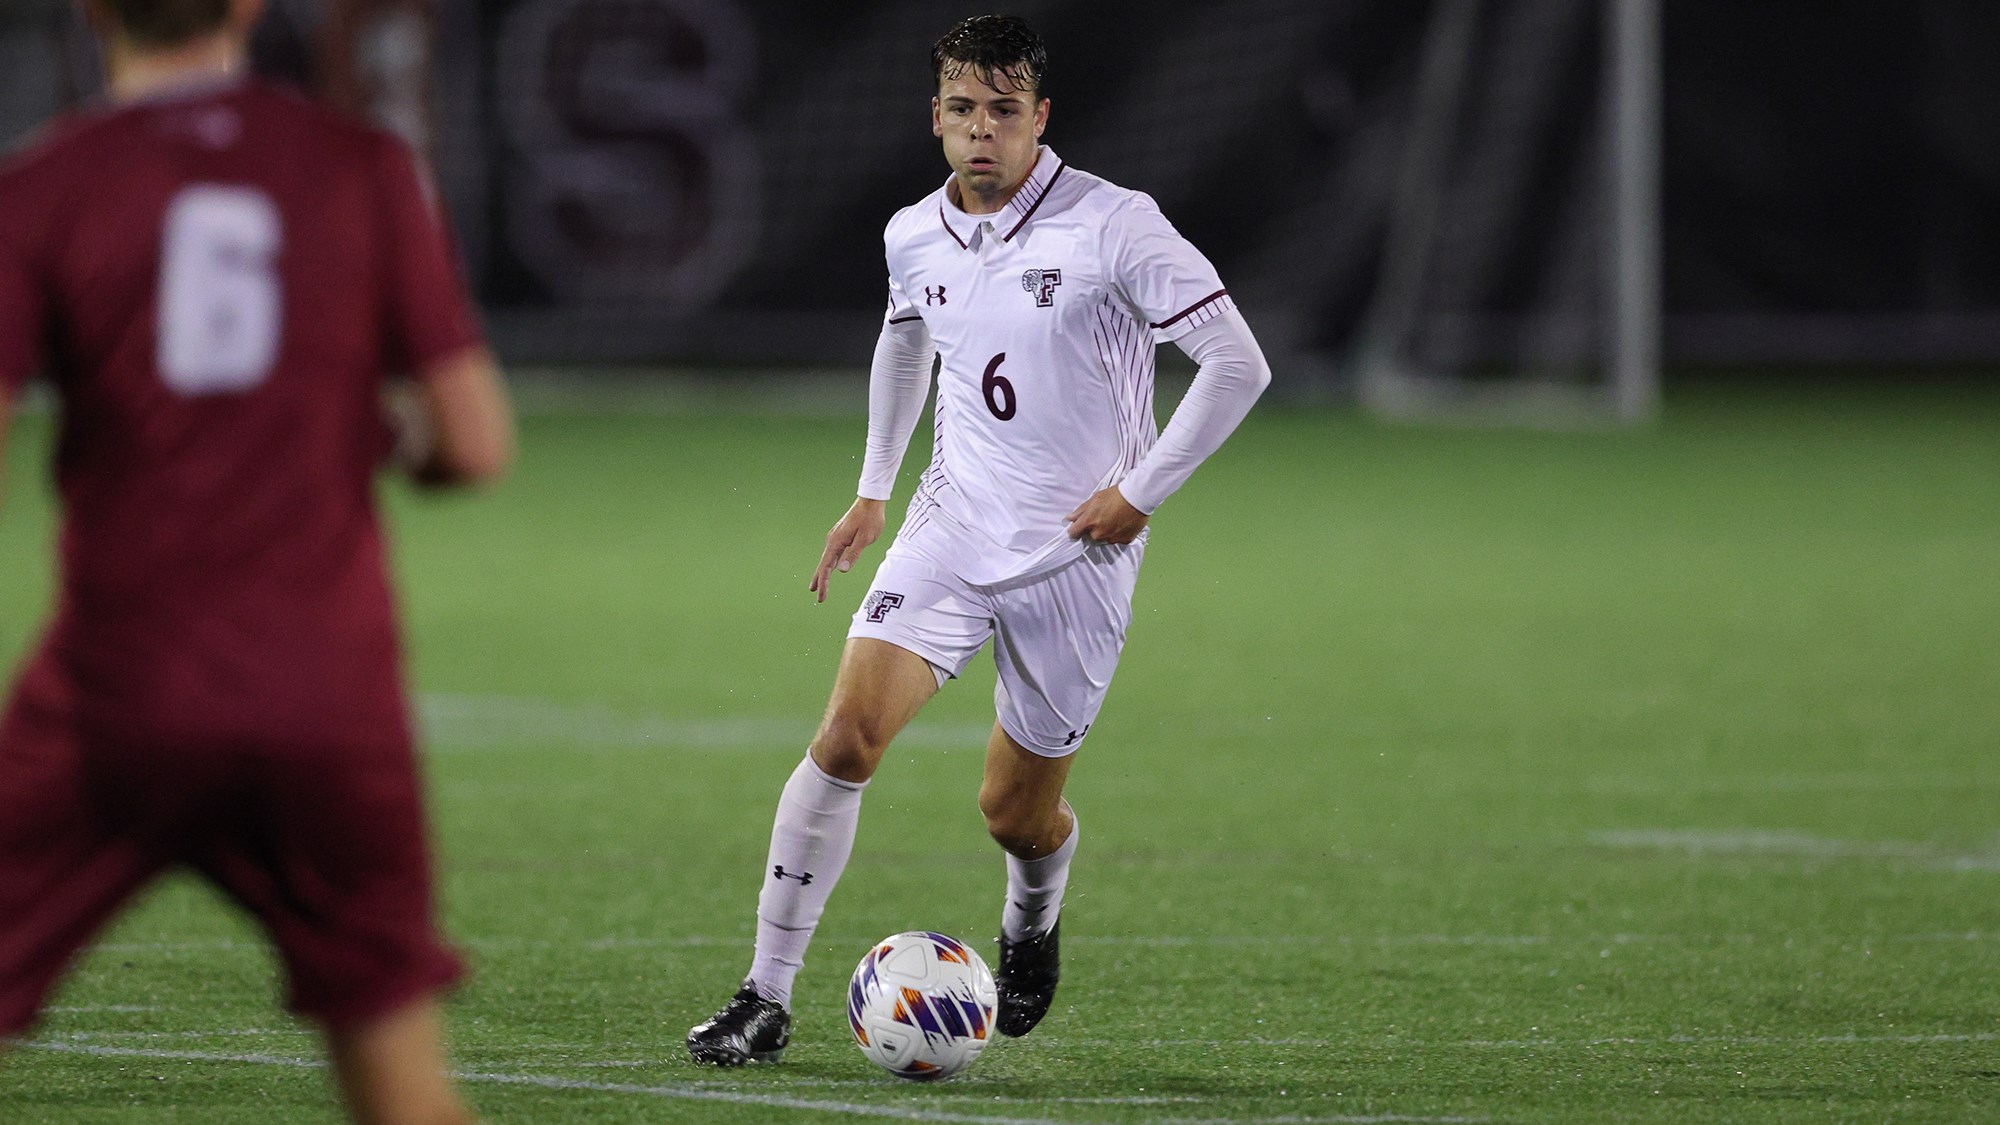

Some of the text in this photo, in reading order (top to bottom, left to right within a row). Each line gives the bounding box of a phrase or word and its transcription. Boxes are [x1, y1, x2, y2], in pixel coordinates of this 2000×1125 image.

[156, 183, 282, 393] 6
[1036, 268, 1062, 308] F
[982, 352, 1017, 422] 6
